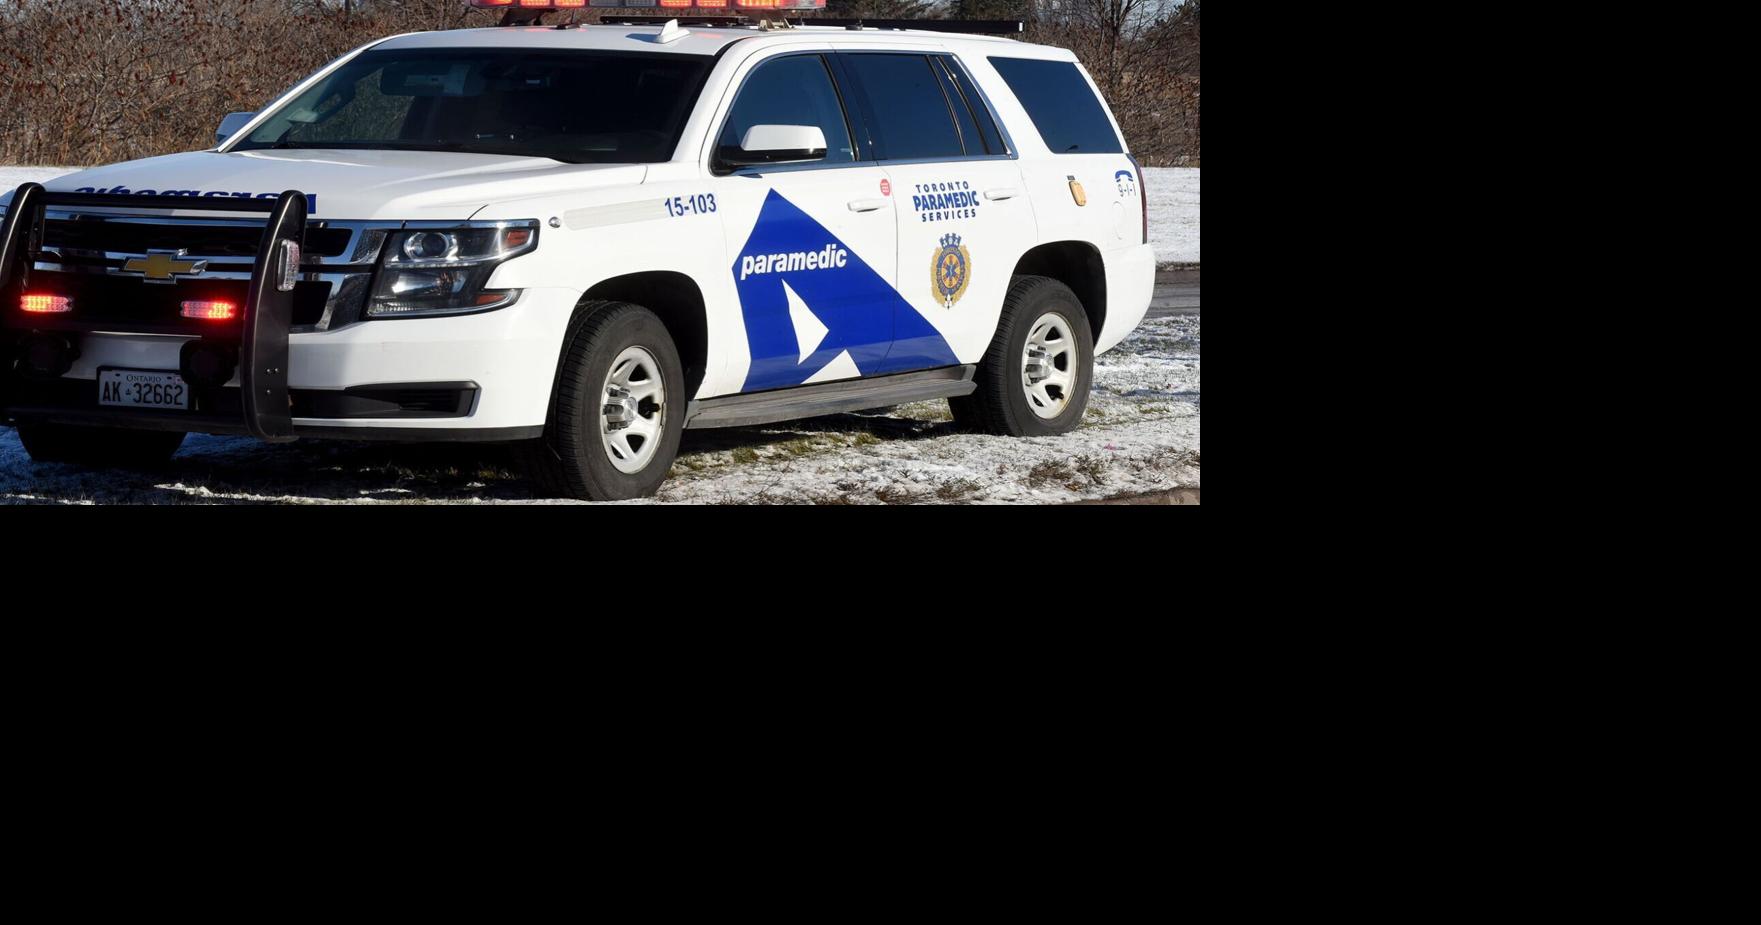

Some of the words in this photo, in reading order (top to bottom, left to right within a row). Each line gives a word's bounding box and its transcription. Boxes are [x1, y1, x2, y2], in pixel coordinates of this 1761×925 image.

[915, 181, 969, 193] TORONTO
[664, 193, 717, 217] 15-103
[912, 190, 980, 212] PARAMEDIC
[921, 208, 976, 222] SERVICES
[740, 243, 847, 280] paramedic
[126, 374, 162, 383] ONTARIO
[102, 381, 121, 402] AK
[133, 382, 183, 405] 32662
